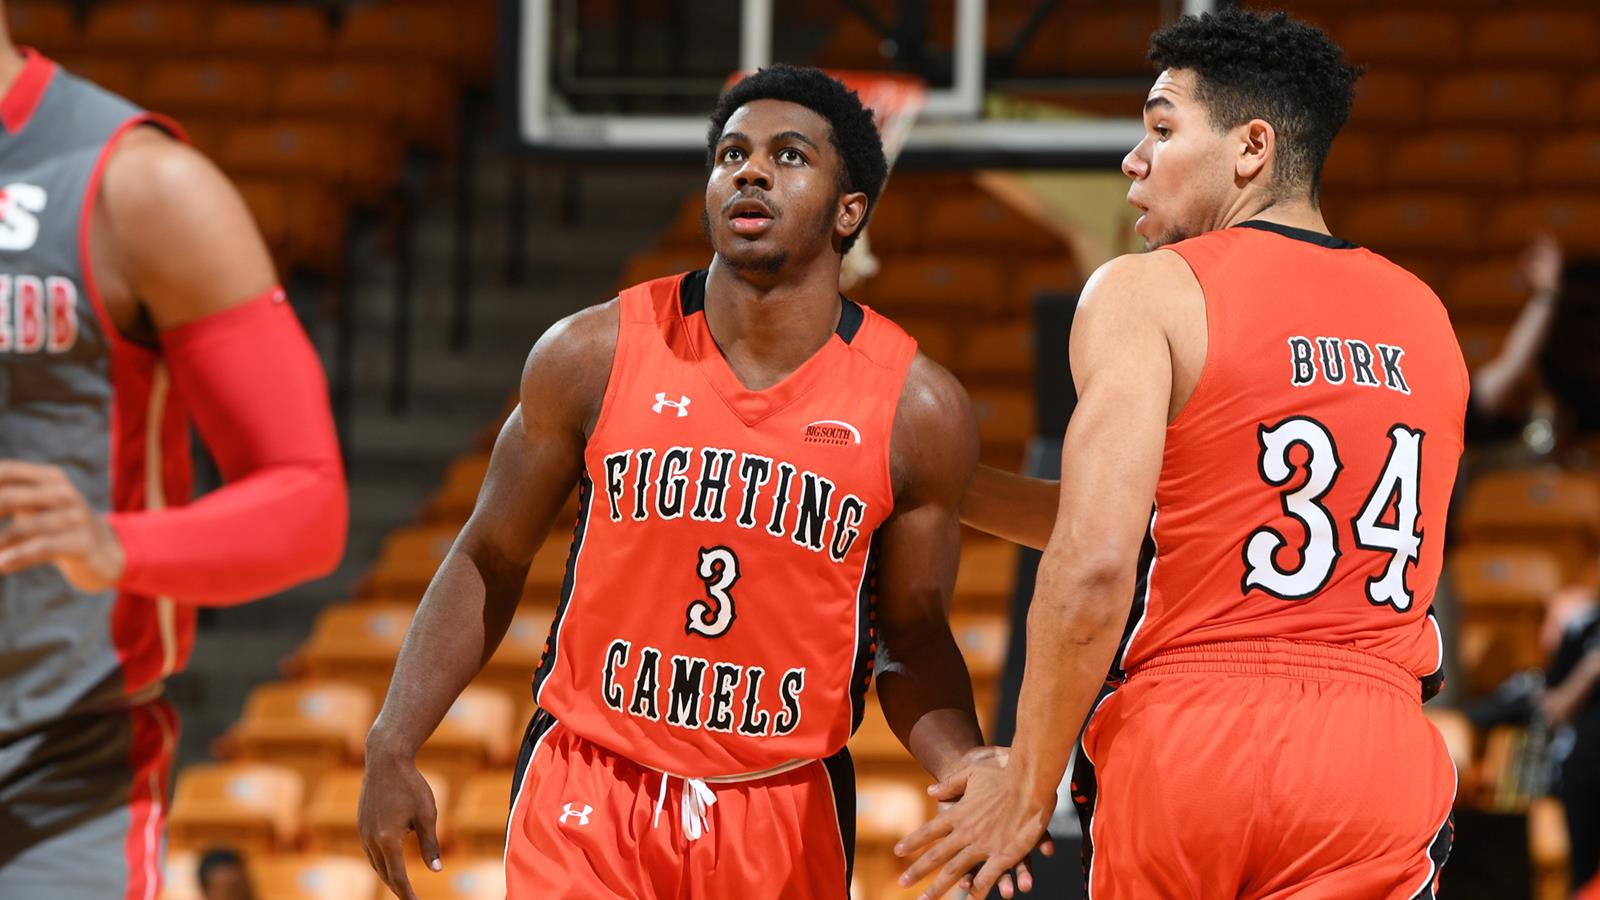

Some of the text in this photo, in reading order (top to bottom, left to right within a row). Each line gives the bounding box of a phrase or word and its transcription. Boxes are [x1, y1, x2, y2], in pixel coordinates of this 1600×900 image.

[1288, 336, 1412, 395] BURK
[805, 426, 851, 440] BIG SOUTH
[604, 446, 867, 562] FIGHTING
[1241, 415, 1425, 613] 34
[685, 545, 741, 638] 3
[602, 639, 805, 736] CAMELS
